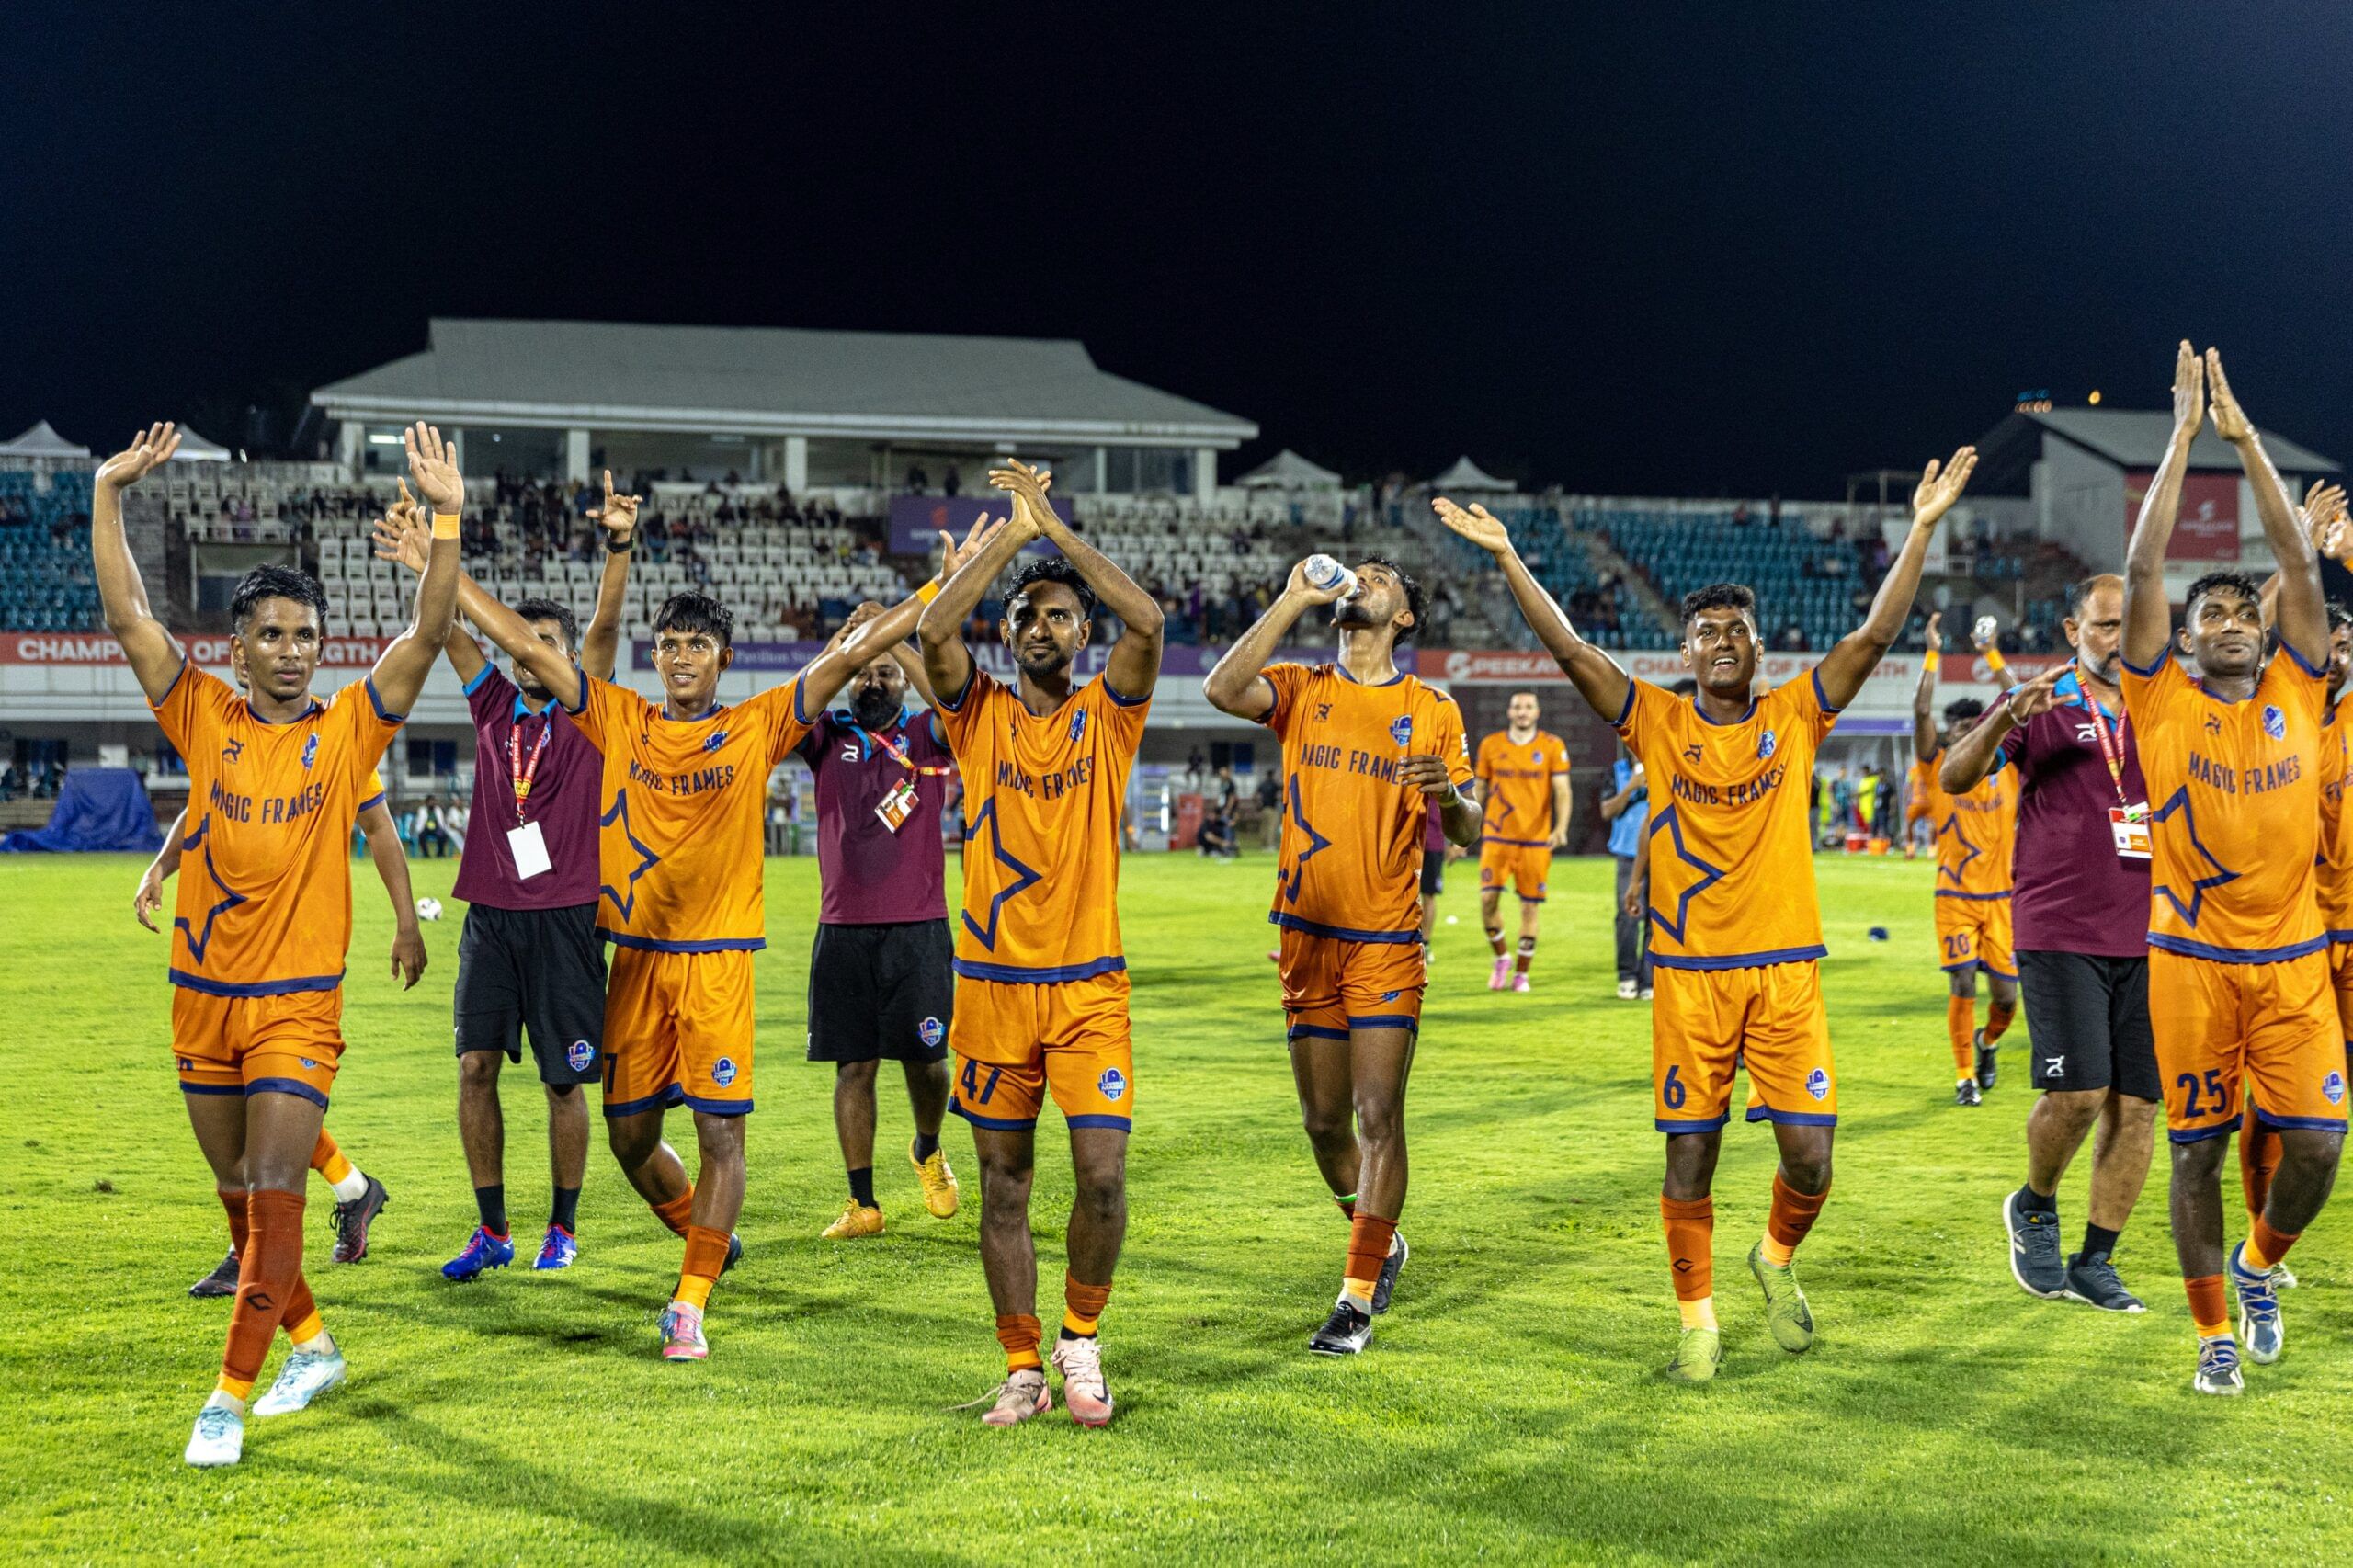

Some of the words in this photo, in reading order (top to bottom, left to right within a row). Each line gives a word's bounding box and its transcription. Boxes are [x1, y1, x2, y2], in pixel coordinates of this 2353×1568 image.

[192, 641, 231, 663] OF
[671, 765, 734, 796] FRAMES
[1349, 750, 1401, 786] FRAME
[1672, 773, 1719, 805] MAGIC
[1728, 763, 1785, 806] FRAMES
[2188, 750, 2236, 794] MAGIC
[2244, 754, 2301, 796] FRAMES
[1943, 933, 1971, 960] 20
[1663, 1064, 1687, 1110] 6
[2177, 1067, 2227, 1119] 25
